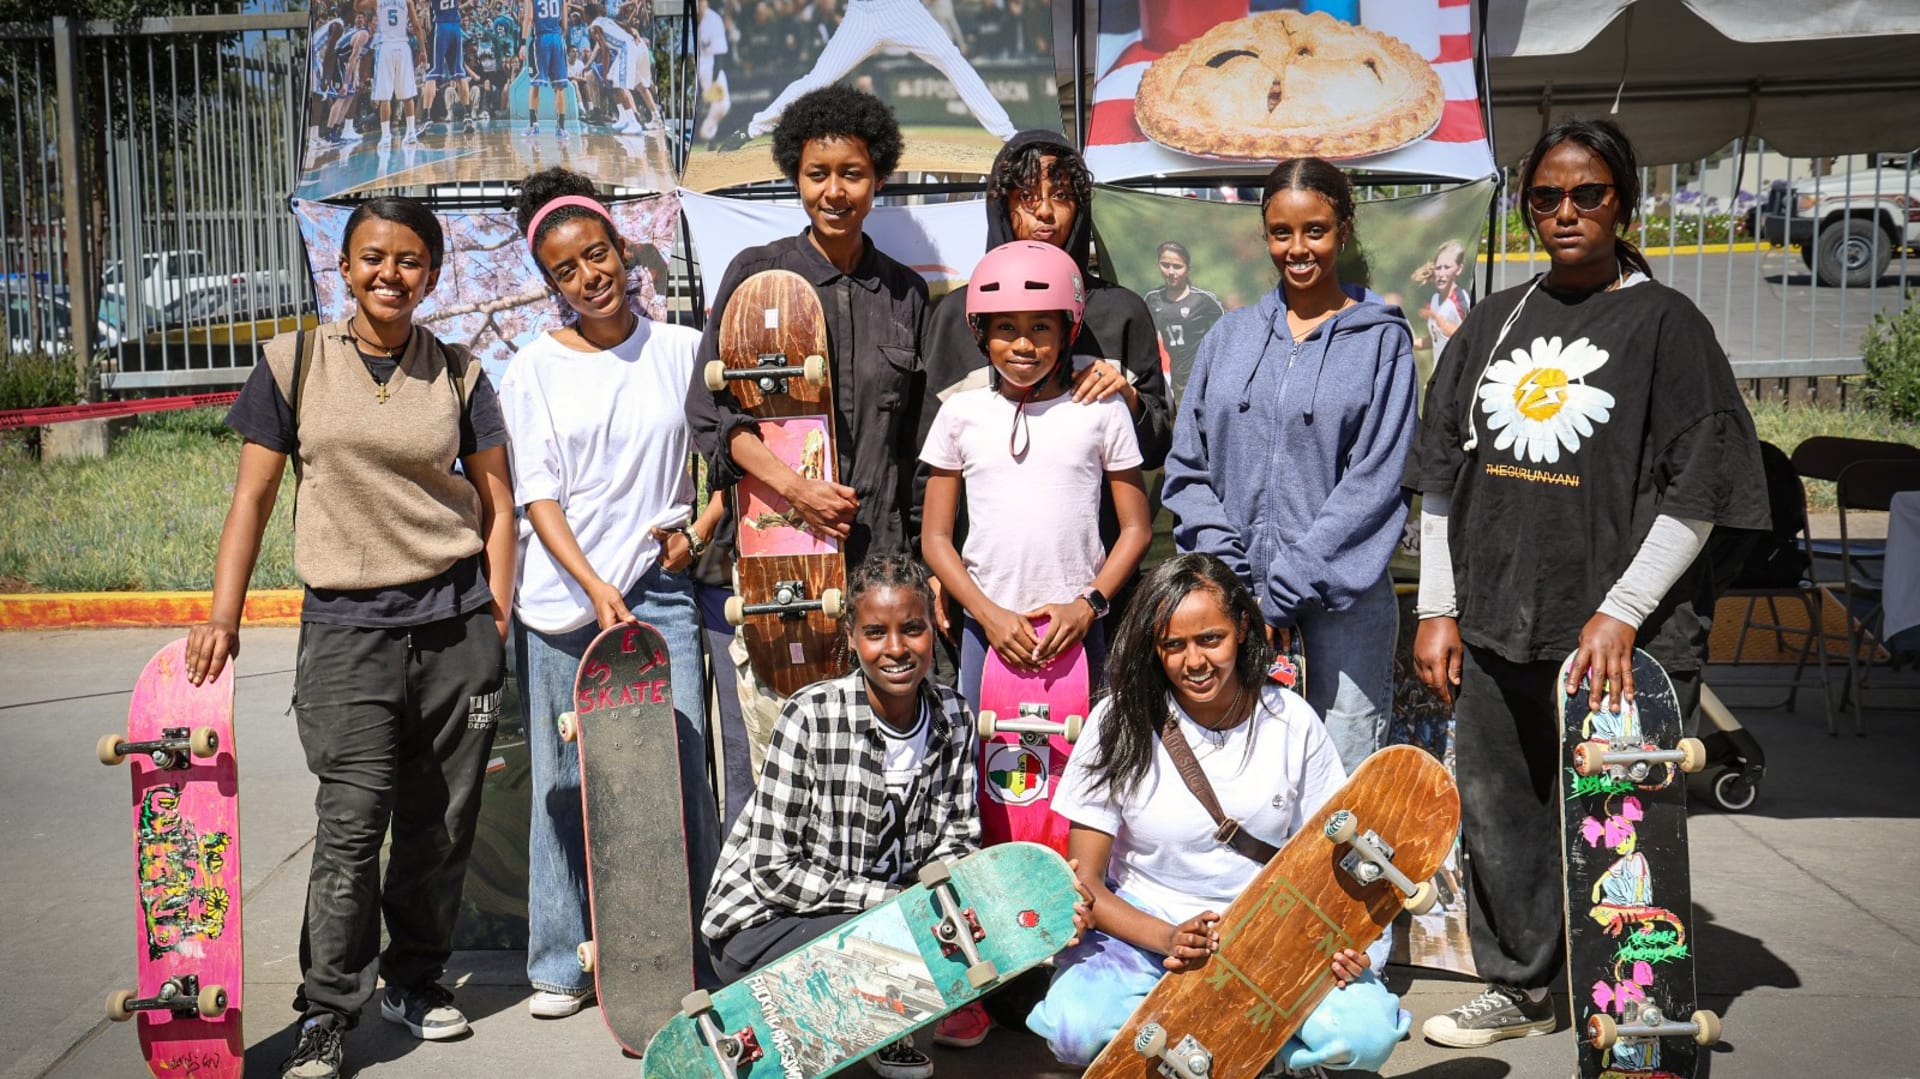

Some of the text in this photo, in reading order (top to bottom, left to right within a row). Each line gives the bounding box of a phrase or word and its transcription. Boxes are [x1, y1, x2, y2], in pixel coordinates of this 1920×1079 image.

[387, 9, 398, 26] 5
[537, 0, 560, 18] 30
[1166, 325, 1185, 346] 17
[577, 679, 667, 714] SKATE
[772, 1030, 804, 1079] AWESOM
